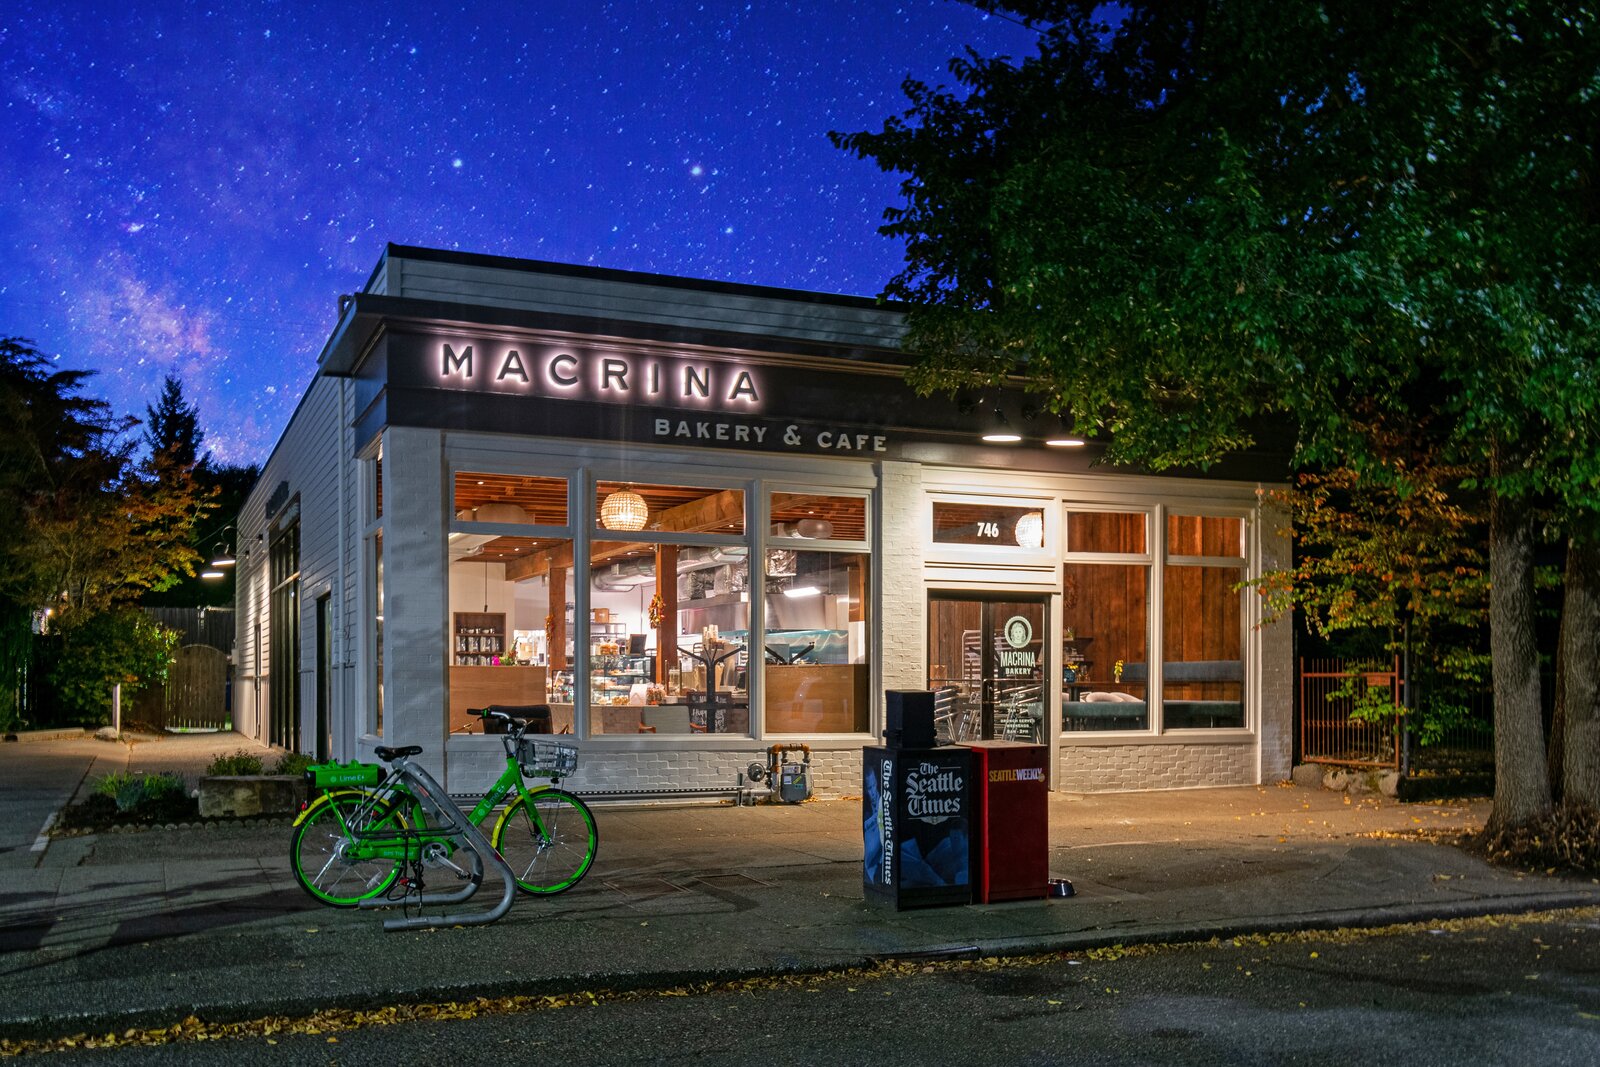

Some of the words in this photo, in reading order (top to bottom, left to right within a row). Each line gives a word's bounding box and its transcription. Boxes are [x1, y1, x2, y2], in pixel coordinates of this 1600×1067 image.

[440, 343, 760, 401] MACRINA
[655, 418, 767, 443] BAKERY
[783, 424, 801, 446] &
[817, 431, 887, 452] CAFE
[977, 522, 999, 538] 746
[1000, 651, 1036, 667] MACRINA
[1005, 667, 1031, 675] BAKERY
[883, 759, 893, 789] The
[920, 762, 939, 776] The
[905, 771, 963, 795] Seattle
[883, 790, 893, 839] Seattle
[907, 794, 961, 816] Times
[884, 840, 894, 885] Times
